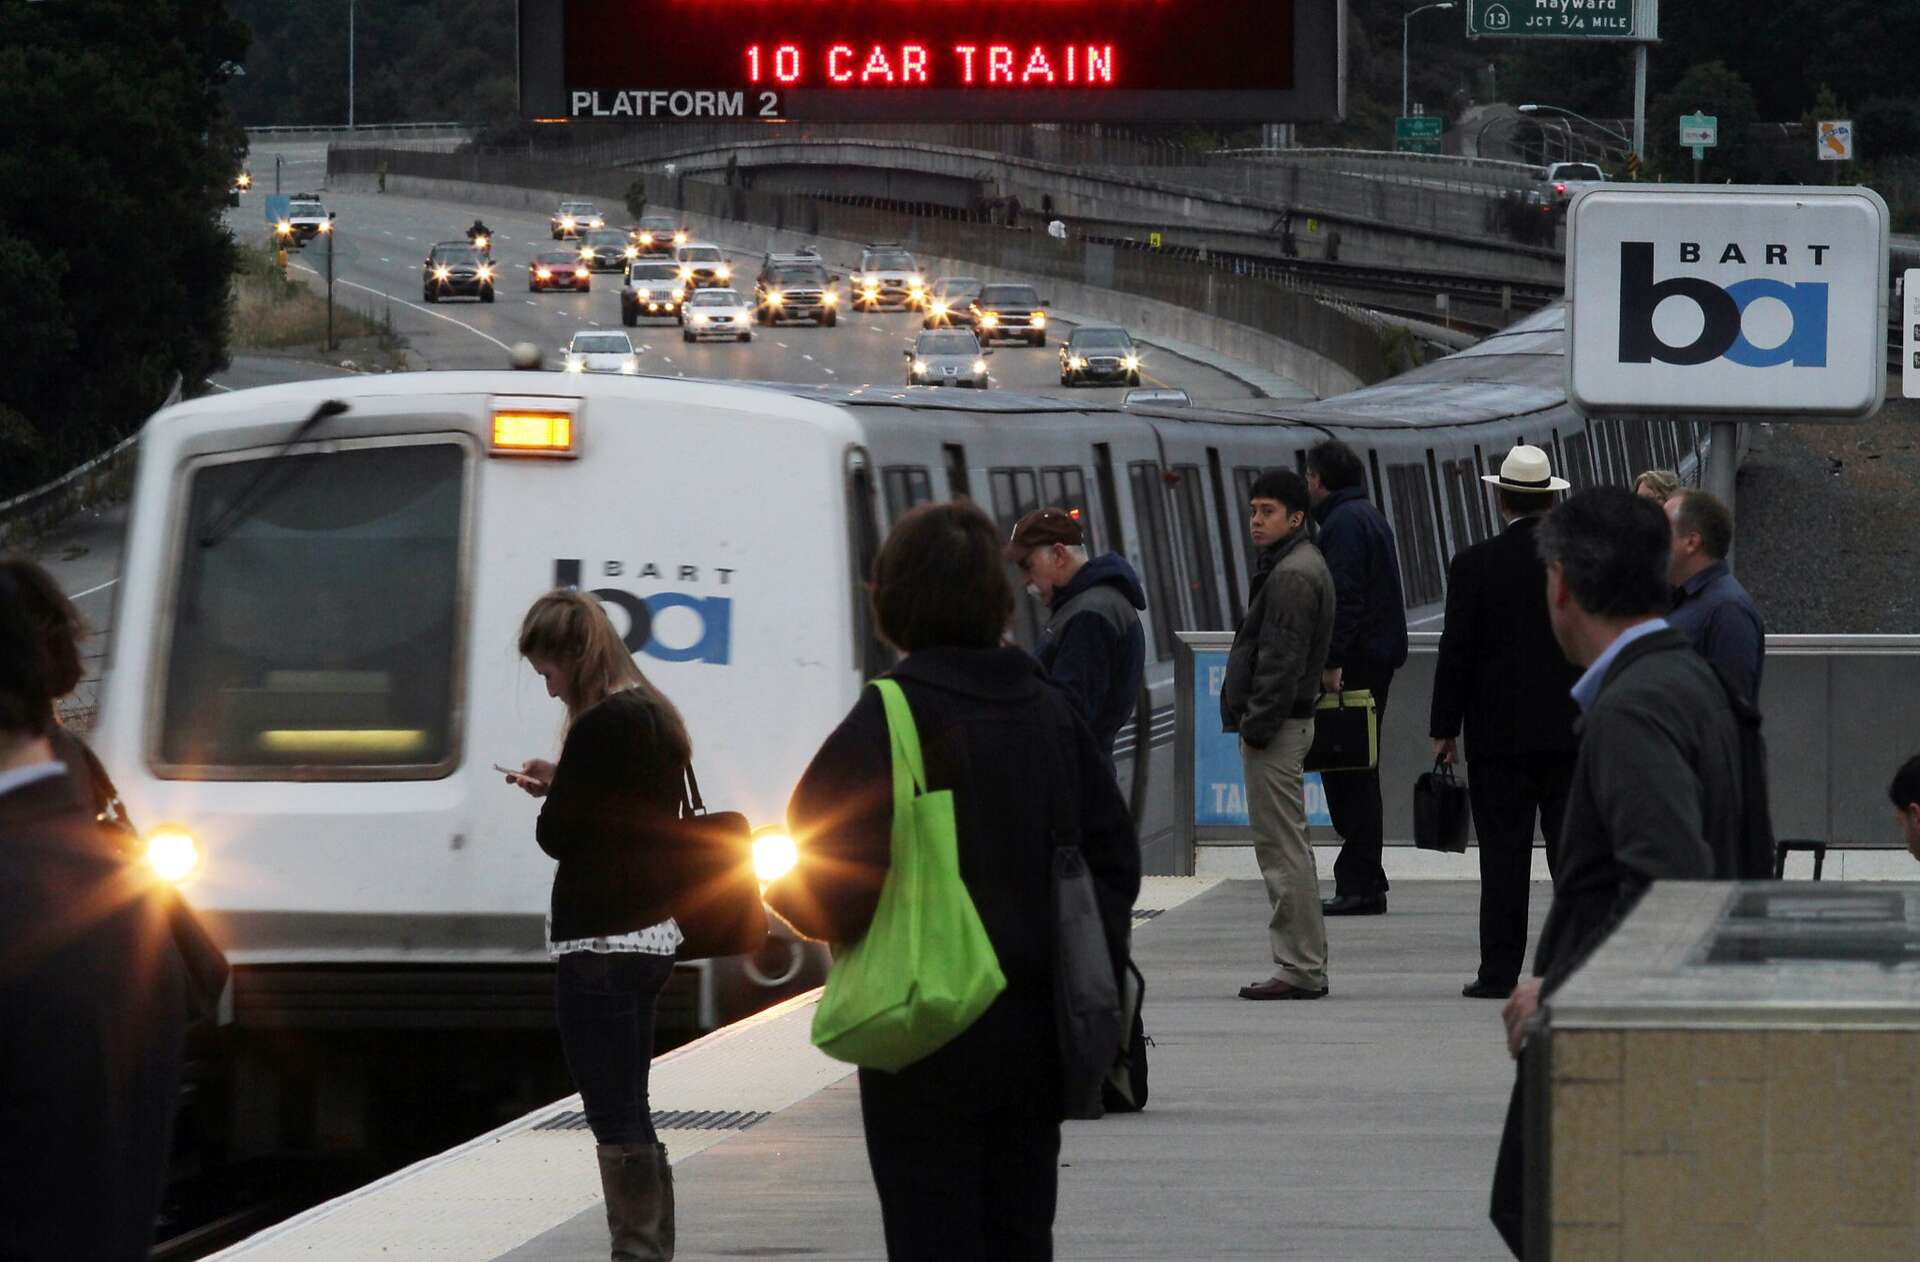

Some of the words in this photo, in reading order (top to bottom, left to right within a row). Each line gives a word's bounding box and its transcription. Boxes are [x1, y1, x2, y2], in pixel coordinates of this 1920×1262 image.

[1536, 0, 1616, 13] Hayward
[1489, 13, 1507, 25] 13
[1526, 16, 1553, 27] JCT
[1561, 15, 1585, 28] 3/4
[1592, 17, 1627, 28] MILE
[748, 45, 800, 82] 10
[829, 45, 926, 82] CAR
[955, 45, 1112, 82] TRAIN
[571, 90, 744, 117] PLATFORM
[758, 90, 779, 116] 2
[1680, 242, 1830, 266] BART
[603, 560, 736, 585] BART
